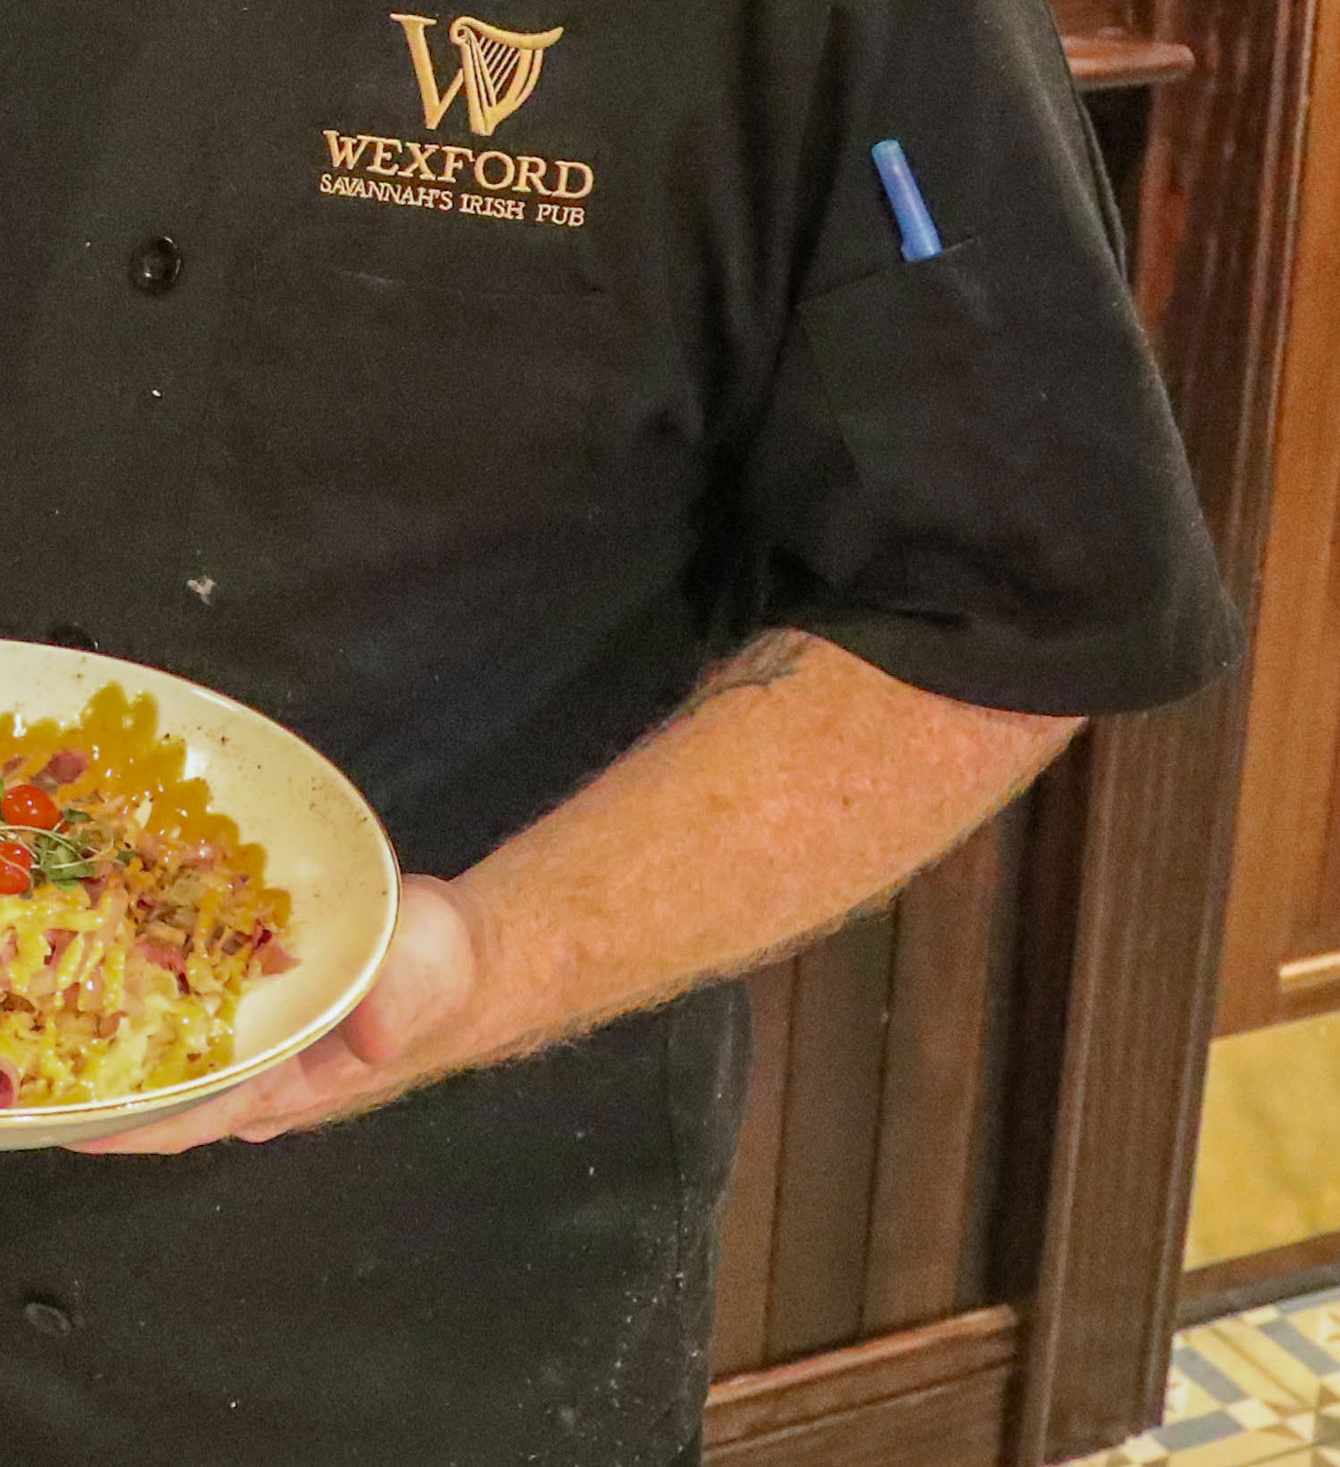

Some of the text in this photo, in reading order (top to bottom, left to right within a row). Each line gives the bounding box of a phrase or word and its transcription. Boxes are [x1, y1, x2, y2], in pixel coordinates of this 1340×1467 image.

[322, 129, 595, 200] WEXFORD
[319, 172, 587, 228] SAVANNAH'S IRISH PUB
